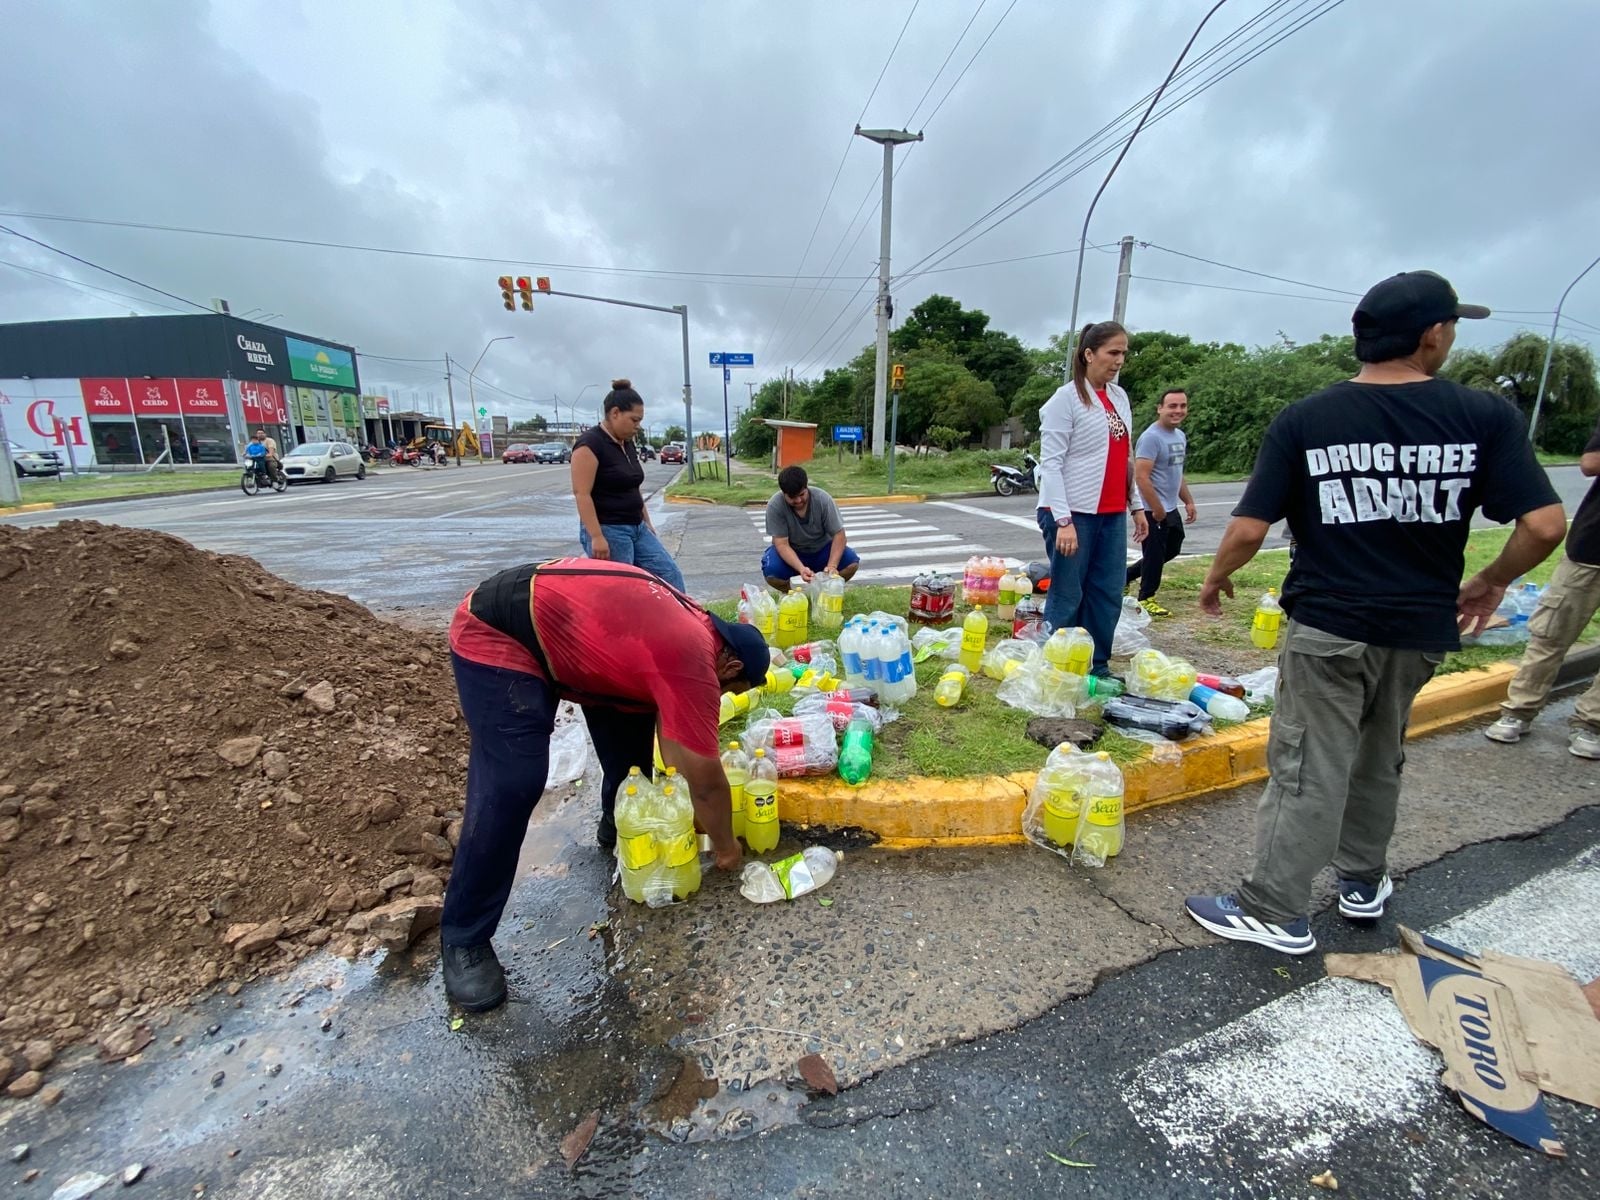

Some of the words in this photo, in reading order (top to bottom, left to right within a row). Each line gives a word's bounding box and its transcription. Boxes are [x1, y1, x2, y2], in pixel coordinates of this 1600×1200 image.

[237, 334, 267, 353] CHAZA
[247, 352, 275, 366] RRETA
[95, 399, 121, 407] POLLO
[142, 399, 169, 407] CERDO
[189, 399, 219, 407] CARNES
[1306, 442, 1396, 477] DRUG
[1400, 442, 1478, 475] FREE
[1318, 477, 1471, 525] ADULT
[1453, 992, 1507, 1091] TORO
